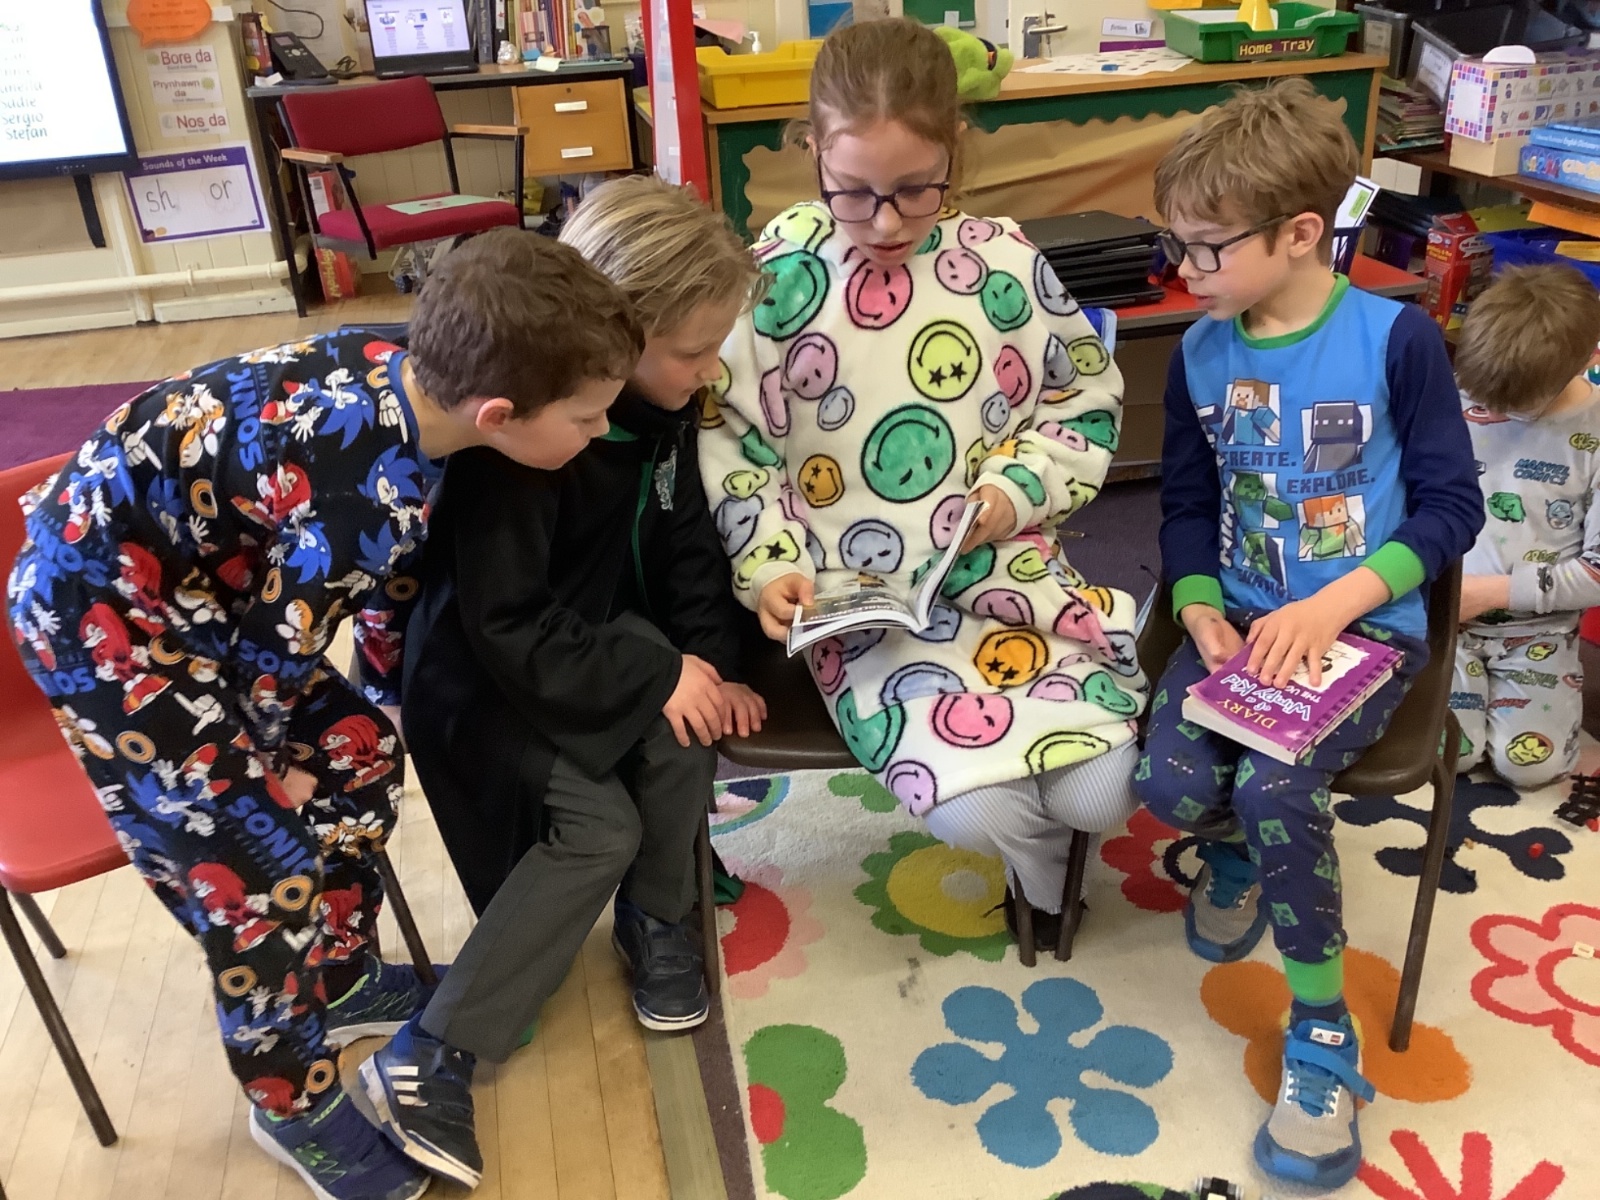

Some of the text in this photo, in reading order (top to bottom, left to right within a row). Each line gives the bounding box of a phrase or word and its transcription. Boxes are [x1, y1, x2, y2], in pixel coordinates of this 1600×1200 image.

[1240, 39, 1315, 56] Home Tray
[160, 48, 212, 66] Bore da
[153, 79, 200, 90] Prynhawn
[174, 89, 187, 97] da
[176, 112, 227, 129] Nos da
[5, 127, 48, 141] Stefan
[142, 153, 228, 171] Sounds of the Week
[145, 178, 233, 213] sh or
[225, 367, 264, 472] SONIC
[1514, 458, 1570, 476] MARVEL
[1286, 468, 1376, 494] EXPLORE.
[1512, 468, 1569, 486] COMICS
[1220, 673, 1311, 722] Wimpy Kid
[1253, 700, 1272, 712] of
[1300, 690, 1322, 704] THE
[1217, 699, 1279, 731] DIARY
